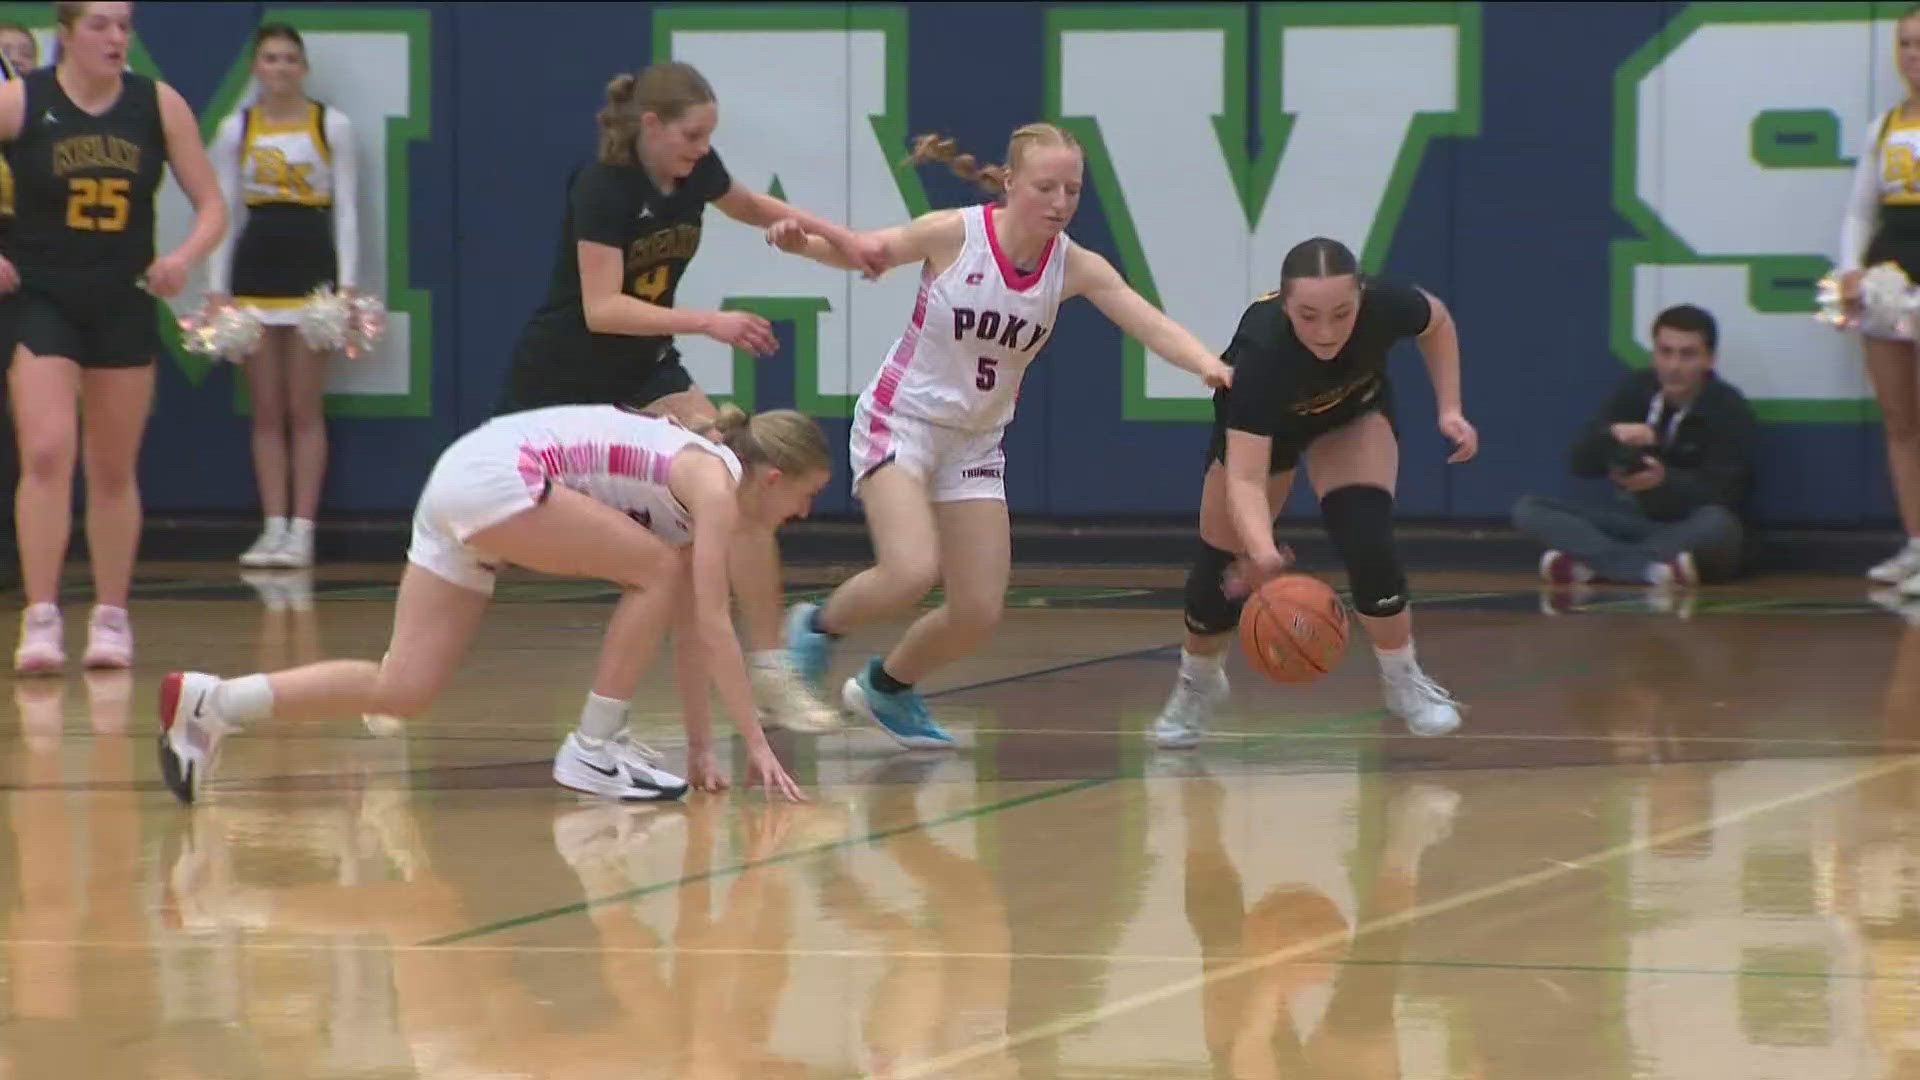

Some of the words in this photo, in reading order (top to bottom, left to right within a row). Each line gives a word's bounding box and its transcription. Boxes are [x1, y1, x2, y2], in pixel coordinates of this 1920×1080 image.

[66, 177, 131, 232] 25
[952, 307, 1048, 353] POKY
[975, 356, 1000, 392] 5
